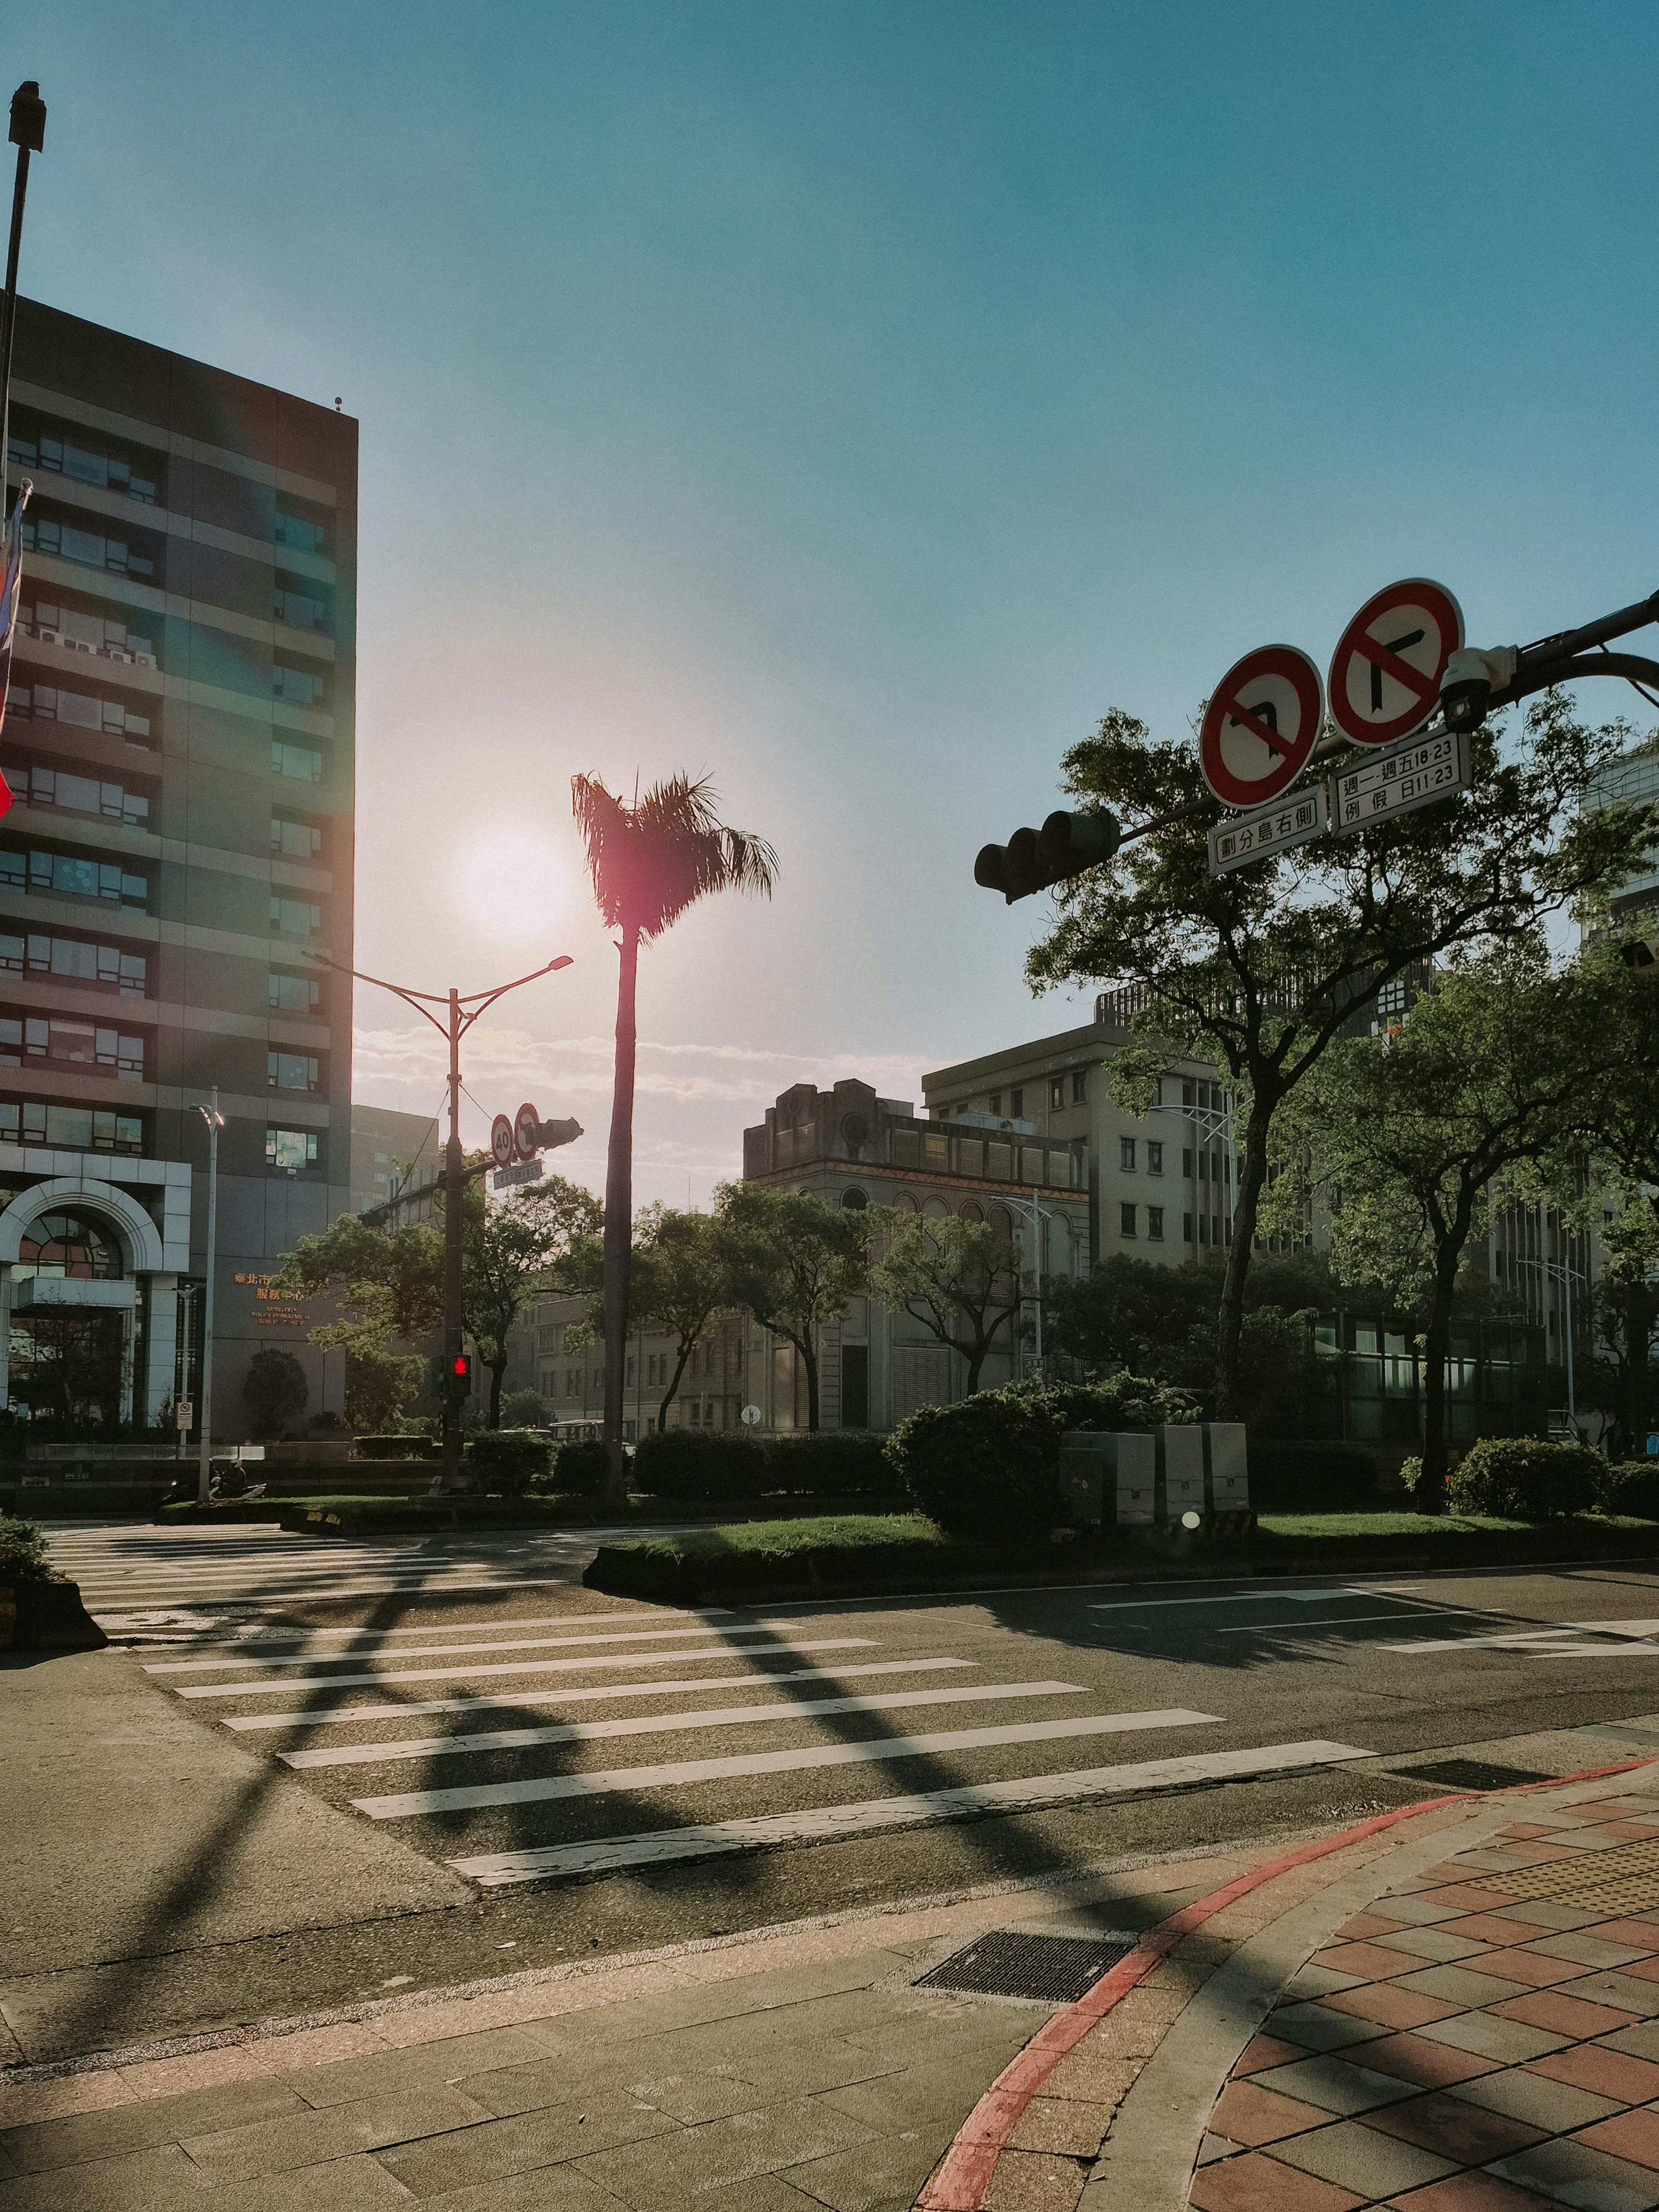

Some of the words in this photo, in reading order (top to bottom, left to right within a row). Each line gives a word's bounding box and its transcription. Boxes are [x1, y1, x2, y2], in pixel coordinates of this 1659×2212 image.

[1220, 804, 1312, 858] 劃分島右側
[496, 1131, 509, 1151] 40
